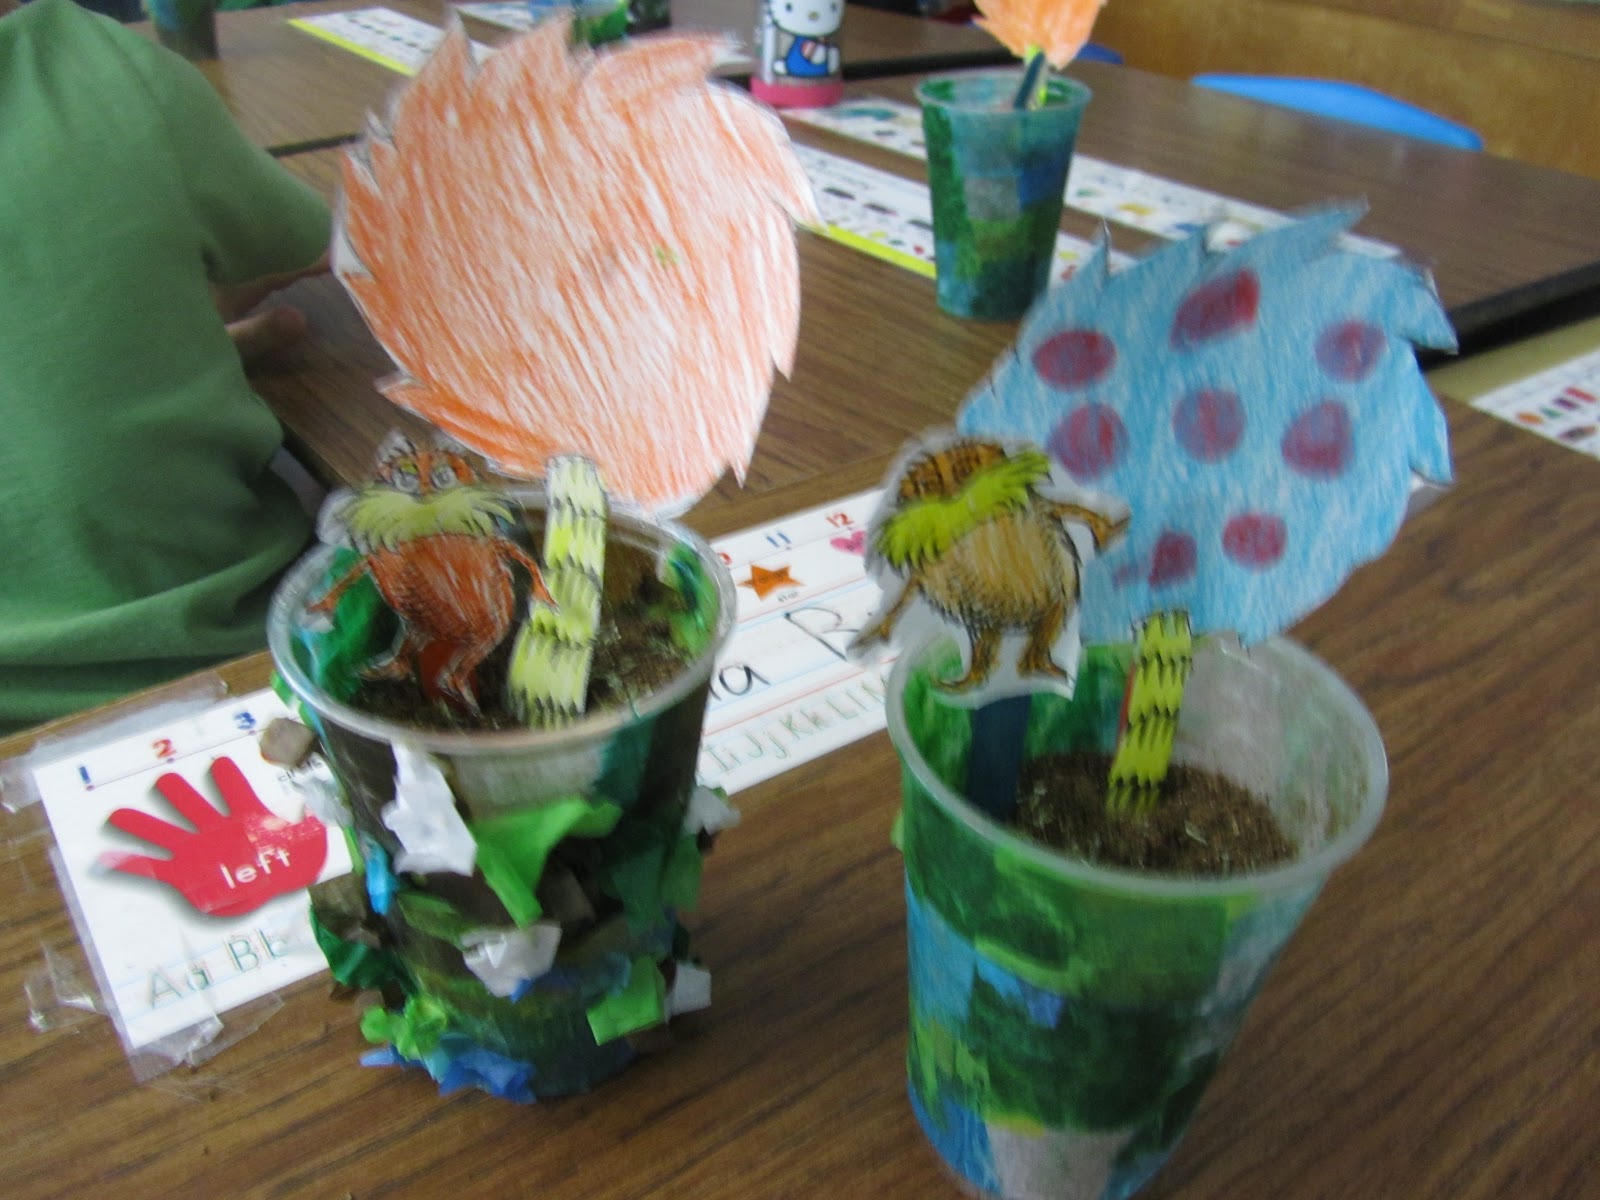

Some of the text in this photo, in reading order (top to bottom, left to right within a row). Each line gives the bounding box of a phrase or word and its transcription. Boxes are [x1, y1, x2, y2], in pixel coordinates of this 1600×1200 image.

[766, 512, 855, 548] 11 12
[79, 711, 256, 785] 1 2 3
[219, 846, 291, 890] left
